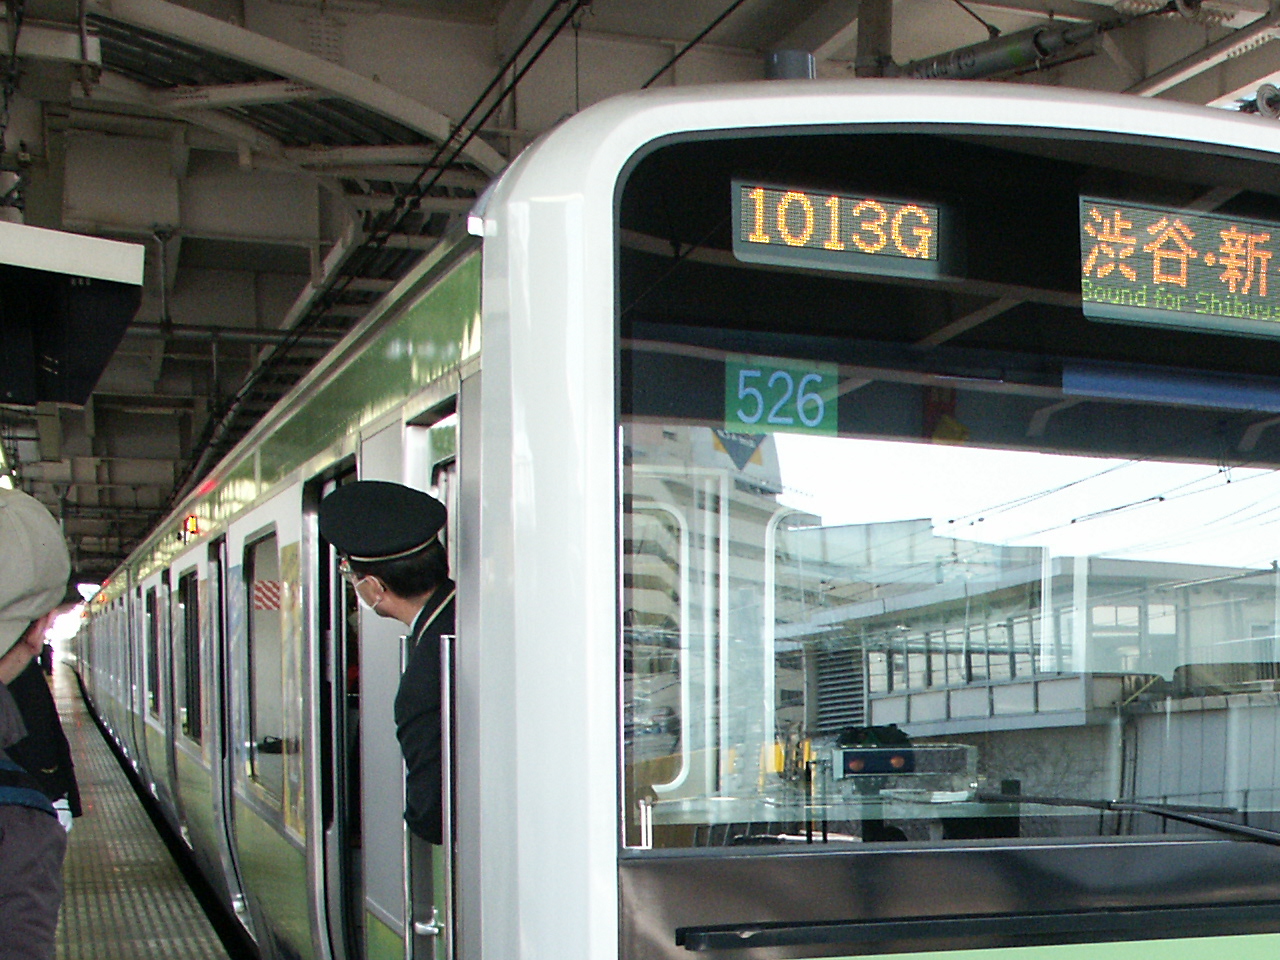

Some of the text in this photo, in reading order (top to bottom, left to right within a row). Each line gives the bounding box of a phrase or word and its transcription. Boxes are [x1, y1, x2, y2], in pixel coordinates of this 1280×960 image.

[749, 187, 932, 259] 1013G
[1081, 278, 1147, 307] Bound
[1154, 287, 1190, 311] for
[737, 369, 824, 427] 526
